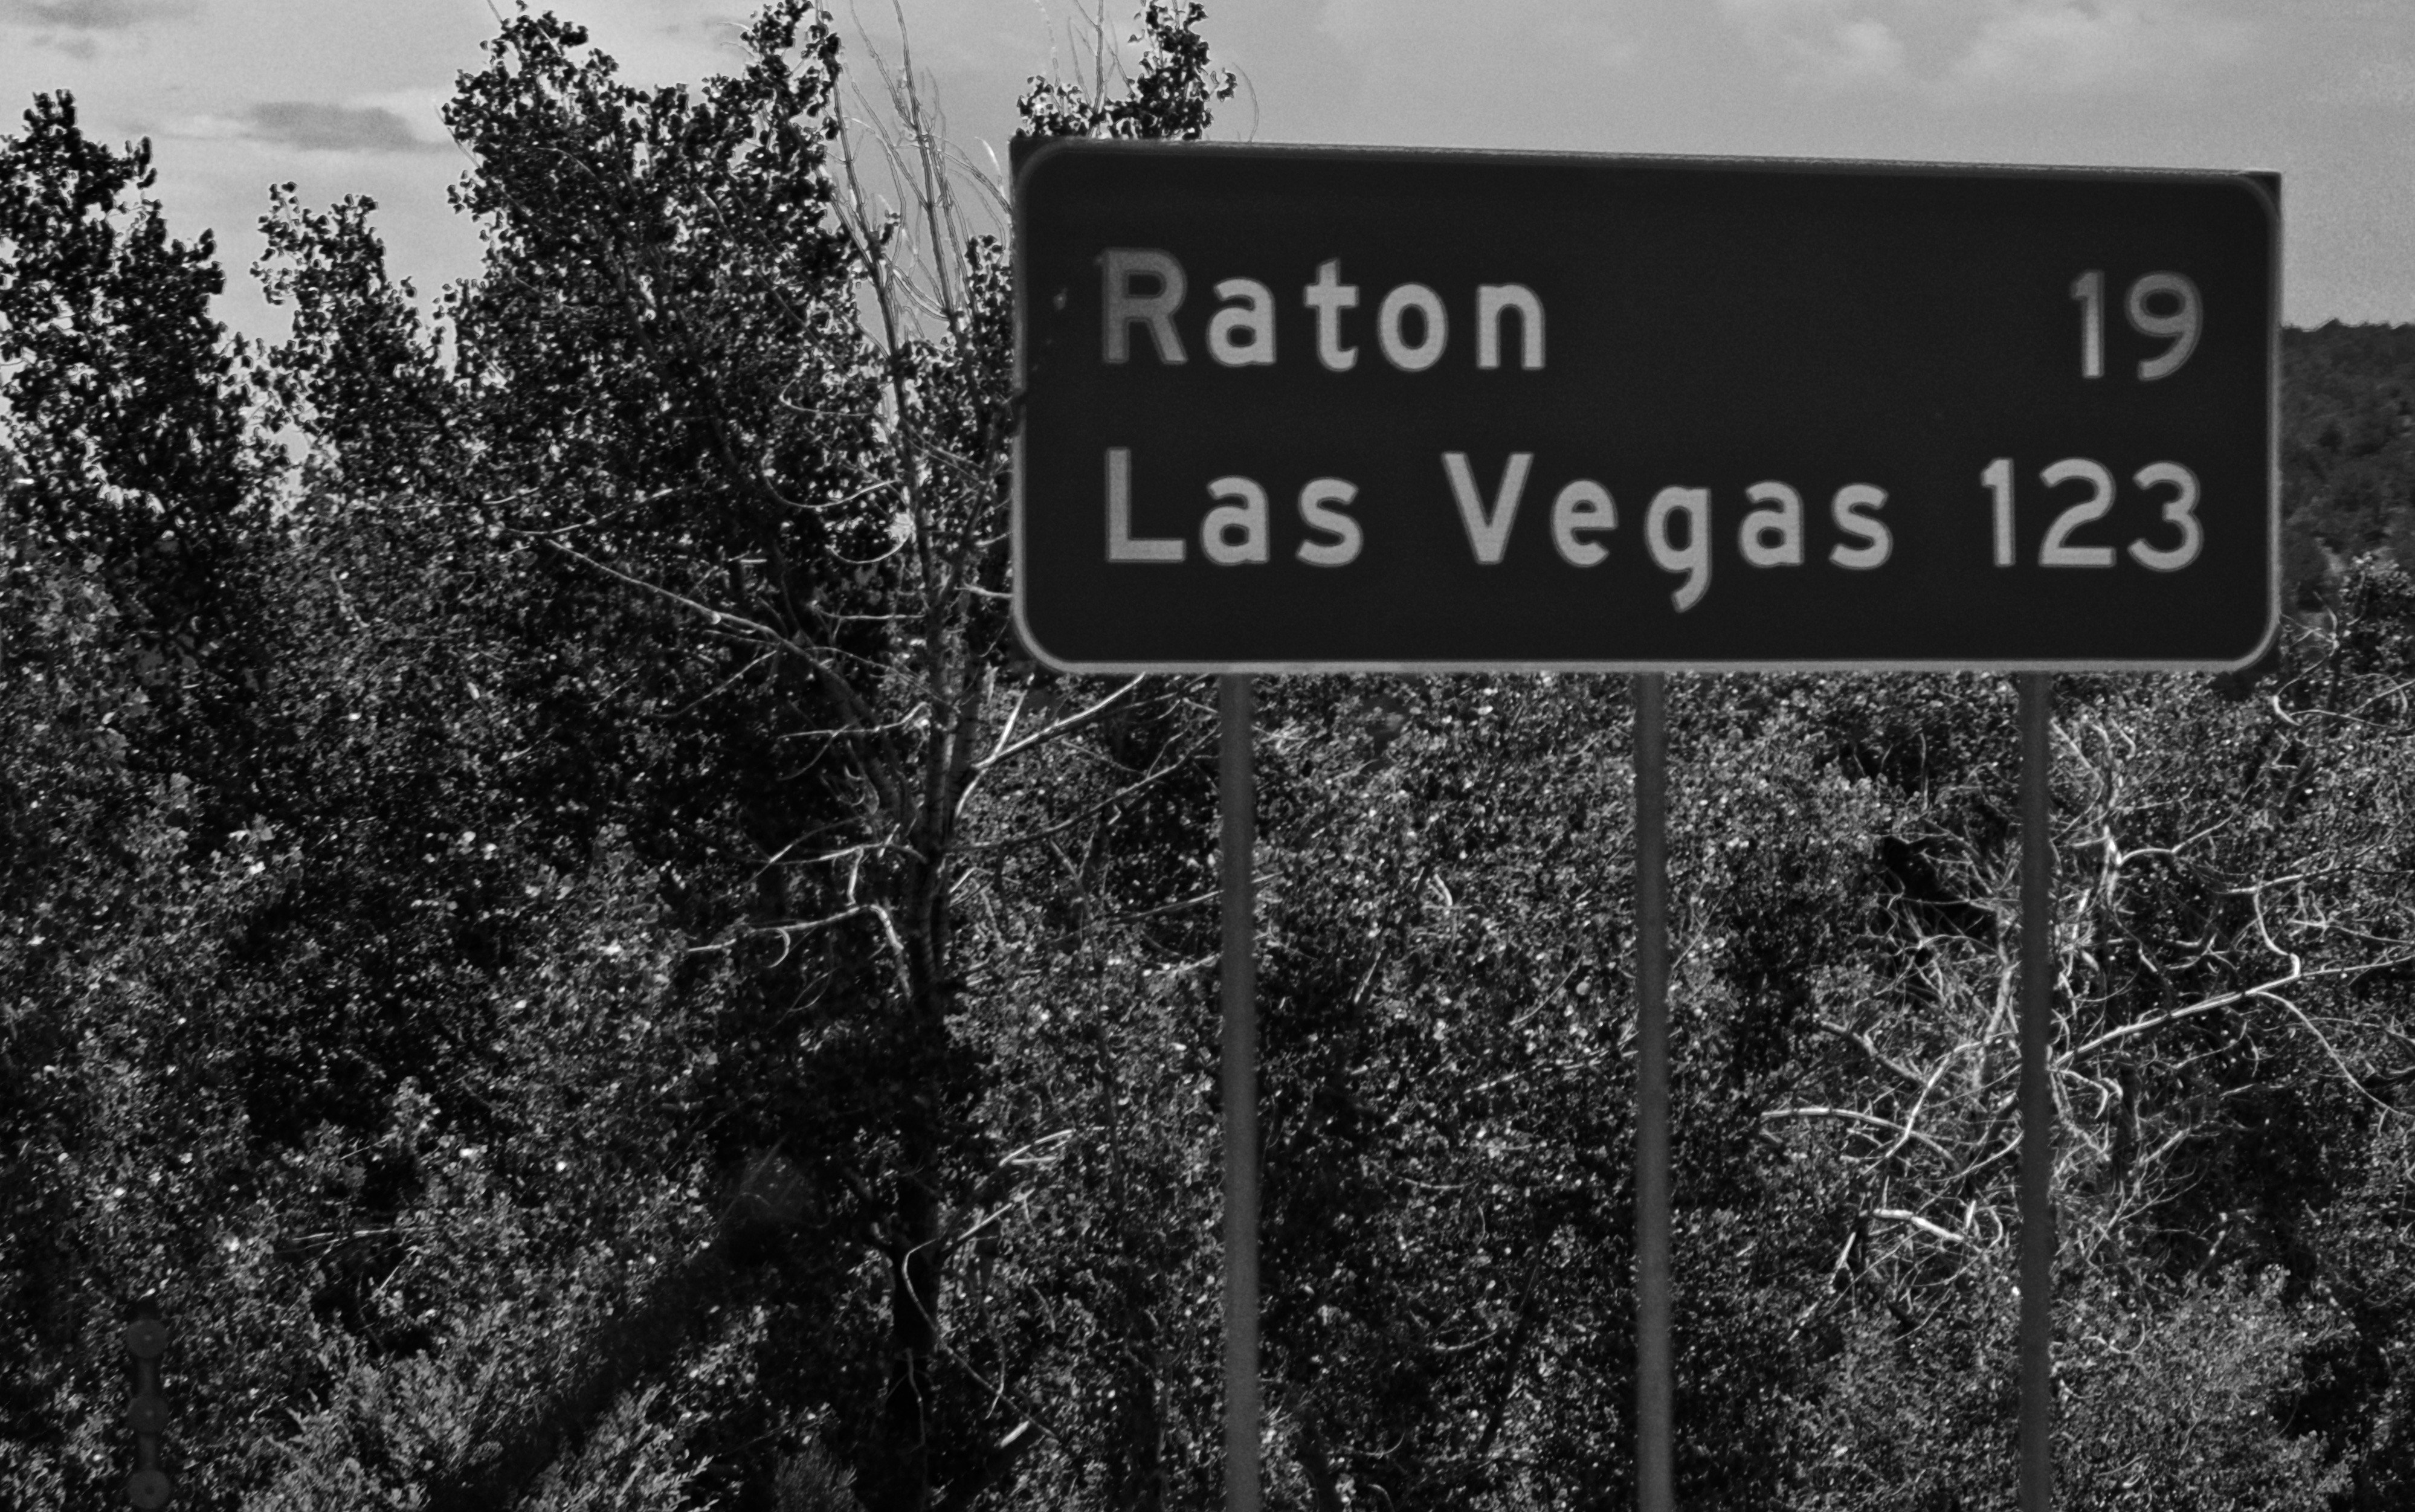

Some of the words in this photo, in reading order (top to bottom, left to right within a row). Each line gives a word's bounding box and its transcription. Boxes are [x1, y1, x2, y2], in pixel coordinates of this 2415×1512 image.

[1101, 249, 1545, 372] Raton
[2070, 272, 2202, 382] 19
[1105, 447, 1363, 568] Las
[1442, 451, 1893, 613] Vegas
[1979, 457, 2203, 571] 123
